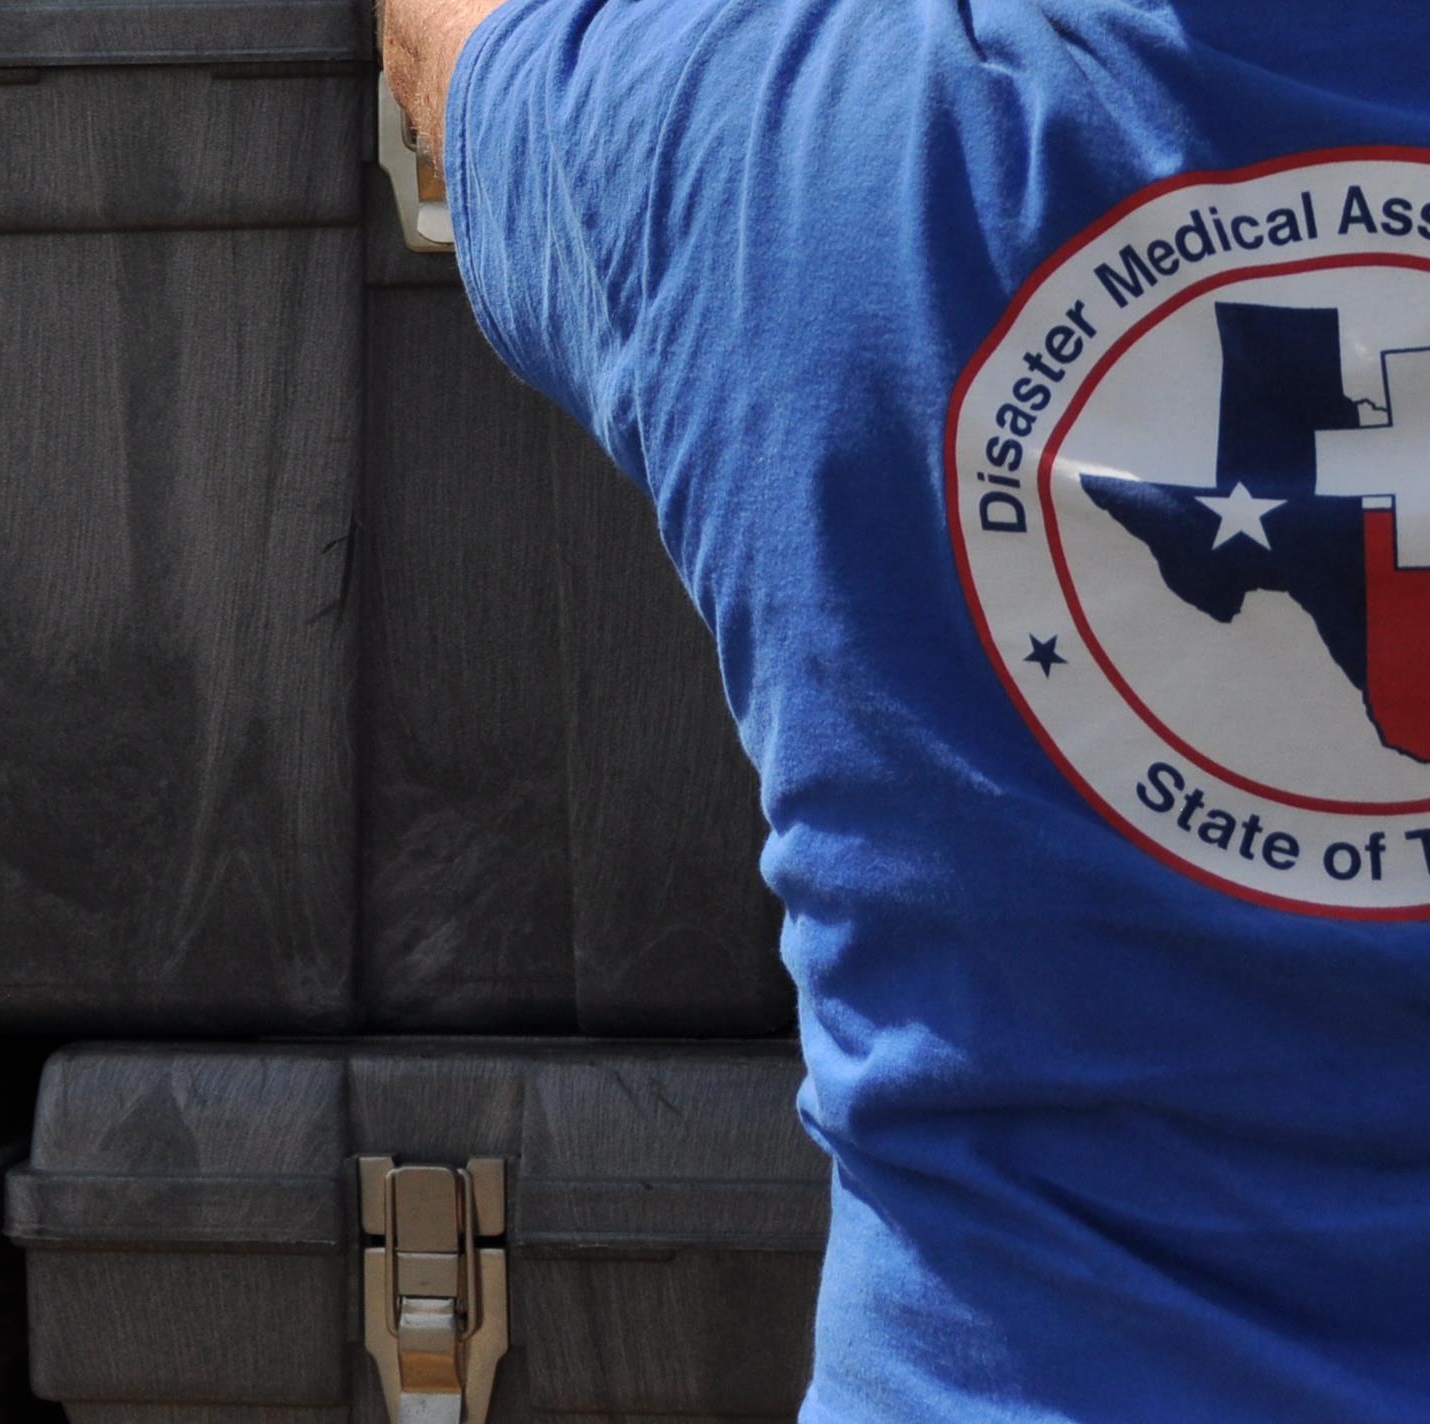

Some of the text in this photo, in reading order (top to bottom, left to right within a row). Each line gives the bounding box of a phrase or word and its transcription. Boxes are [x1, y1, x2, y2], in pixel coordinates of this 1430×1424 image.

[979, 299, 1100, 536] Disaster
[1091, 191, 1320, 310] Medical
[1133, 760, 1303, 872] State
[1321, 831, 1388, 882] of
